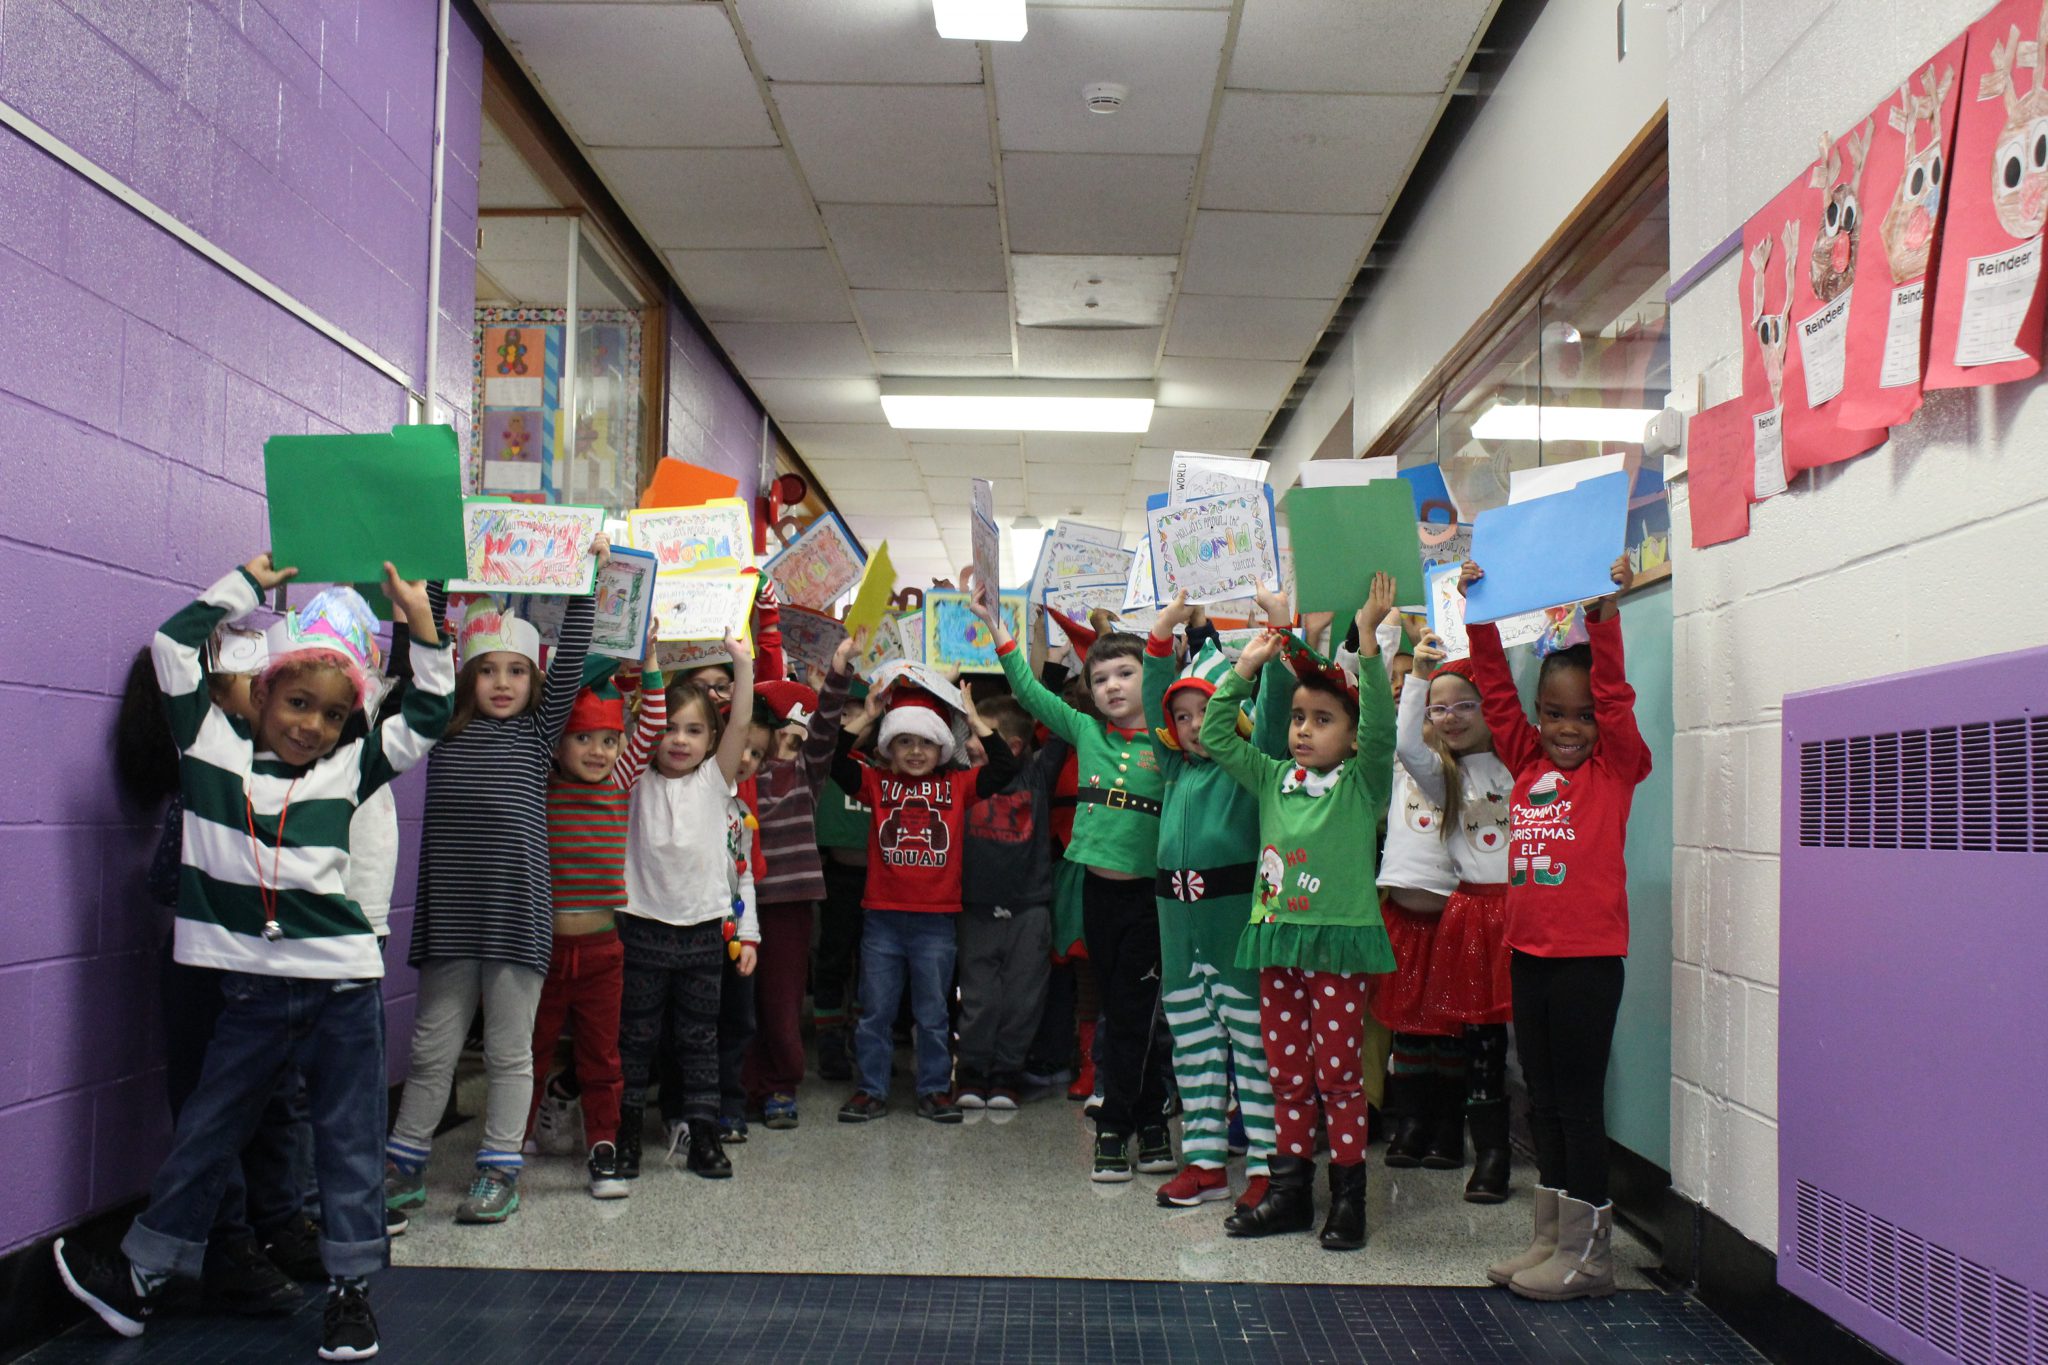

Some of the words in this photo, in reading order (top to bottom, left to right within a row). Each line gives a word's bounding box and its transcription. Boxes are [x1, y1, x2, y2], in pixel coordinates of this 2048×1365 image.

[1977, 251, 2032, 277] Reindeer
[1805, 302, 1846, 336] Reindeer
[1176, 463, 1186, 491] WORLD
[656, 535, 731, 565] World
[1172, 522, 1252, 568] World
[881, 780, 952, 804] RUMBLE
[1512, 800, 1572, 819] MOMMY'S
[882, 849, 947, 868] SQUAD
[1286, 848, 1307, 867] HO
[1521, 843, 1546, 855] ELF
[1297, 872, 1320, 893] HO
[1287, 896, 1310, 912] HO
